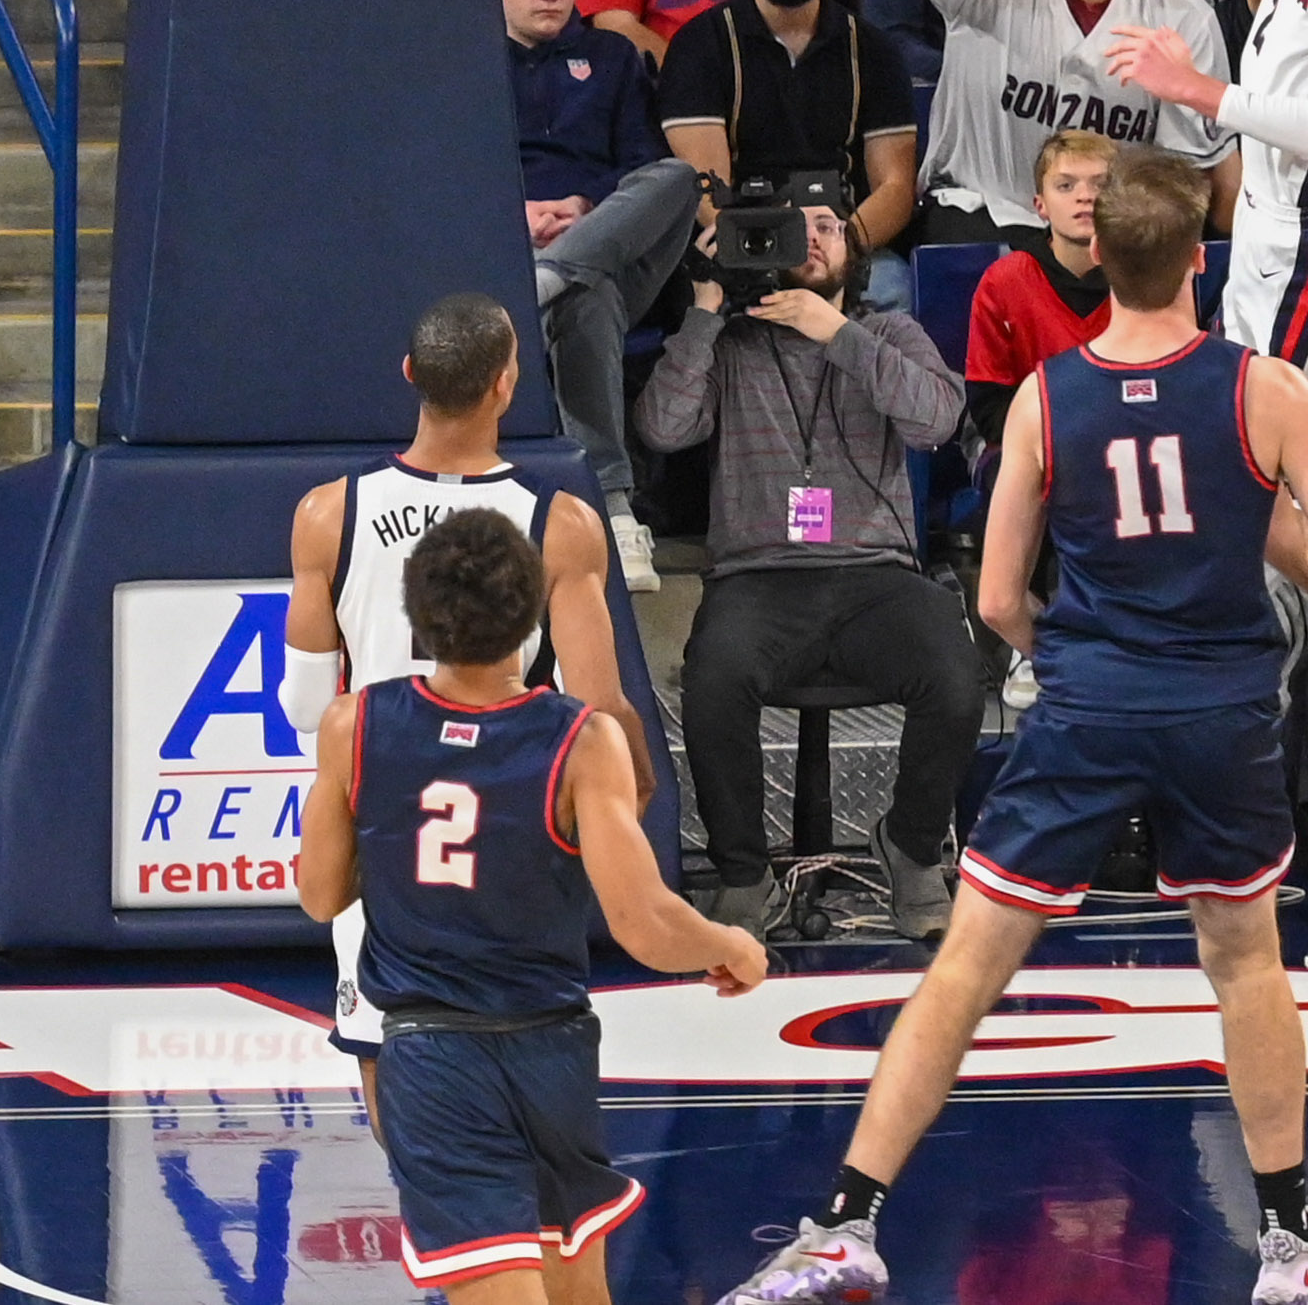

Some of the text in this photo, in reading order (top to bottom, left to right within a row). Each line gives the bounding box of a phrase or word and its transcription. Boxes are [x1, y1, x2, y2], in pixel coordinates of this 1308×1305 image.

[1000, 73, 1148, 143] GONZAGA
[372, 505, 454, 547] HICK
[1105, 433, 1195, 540] 11
[415, 780, 480, 889] 2
